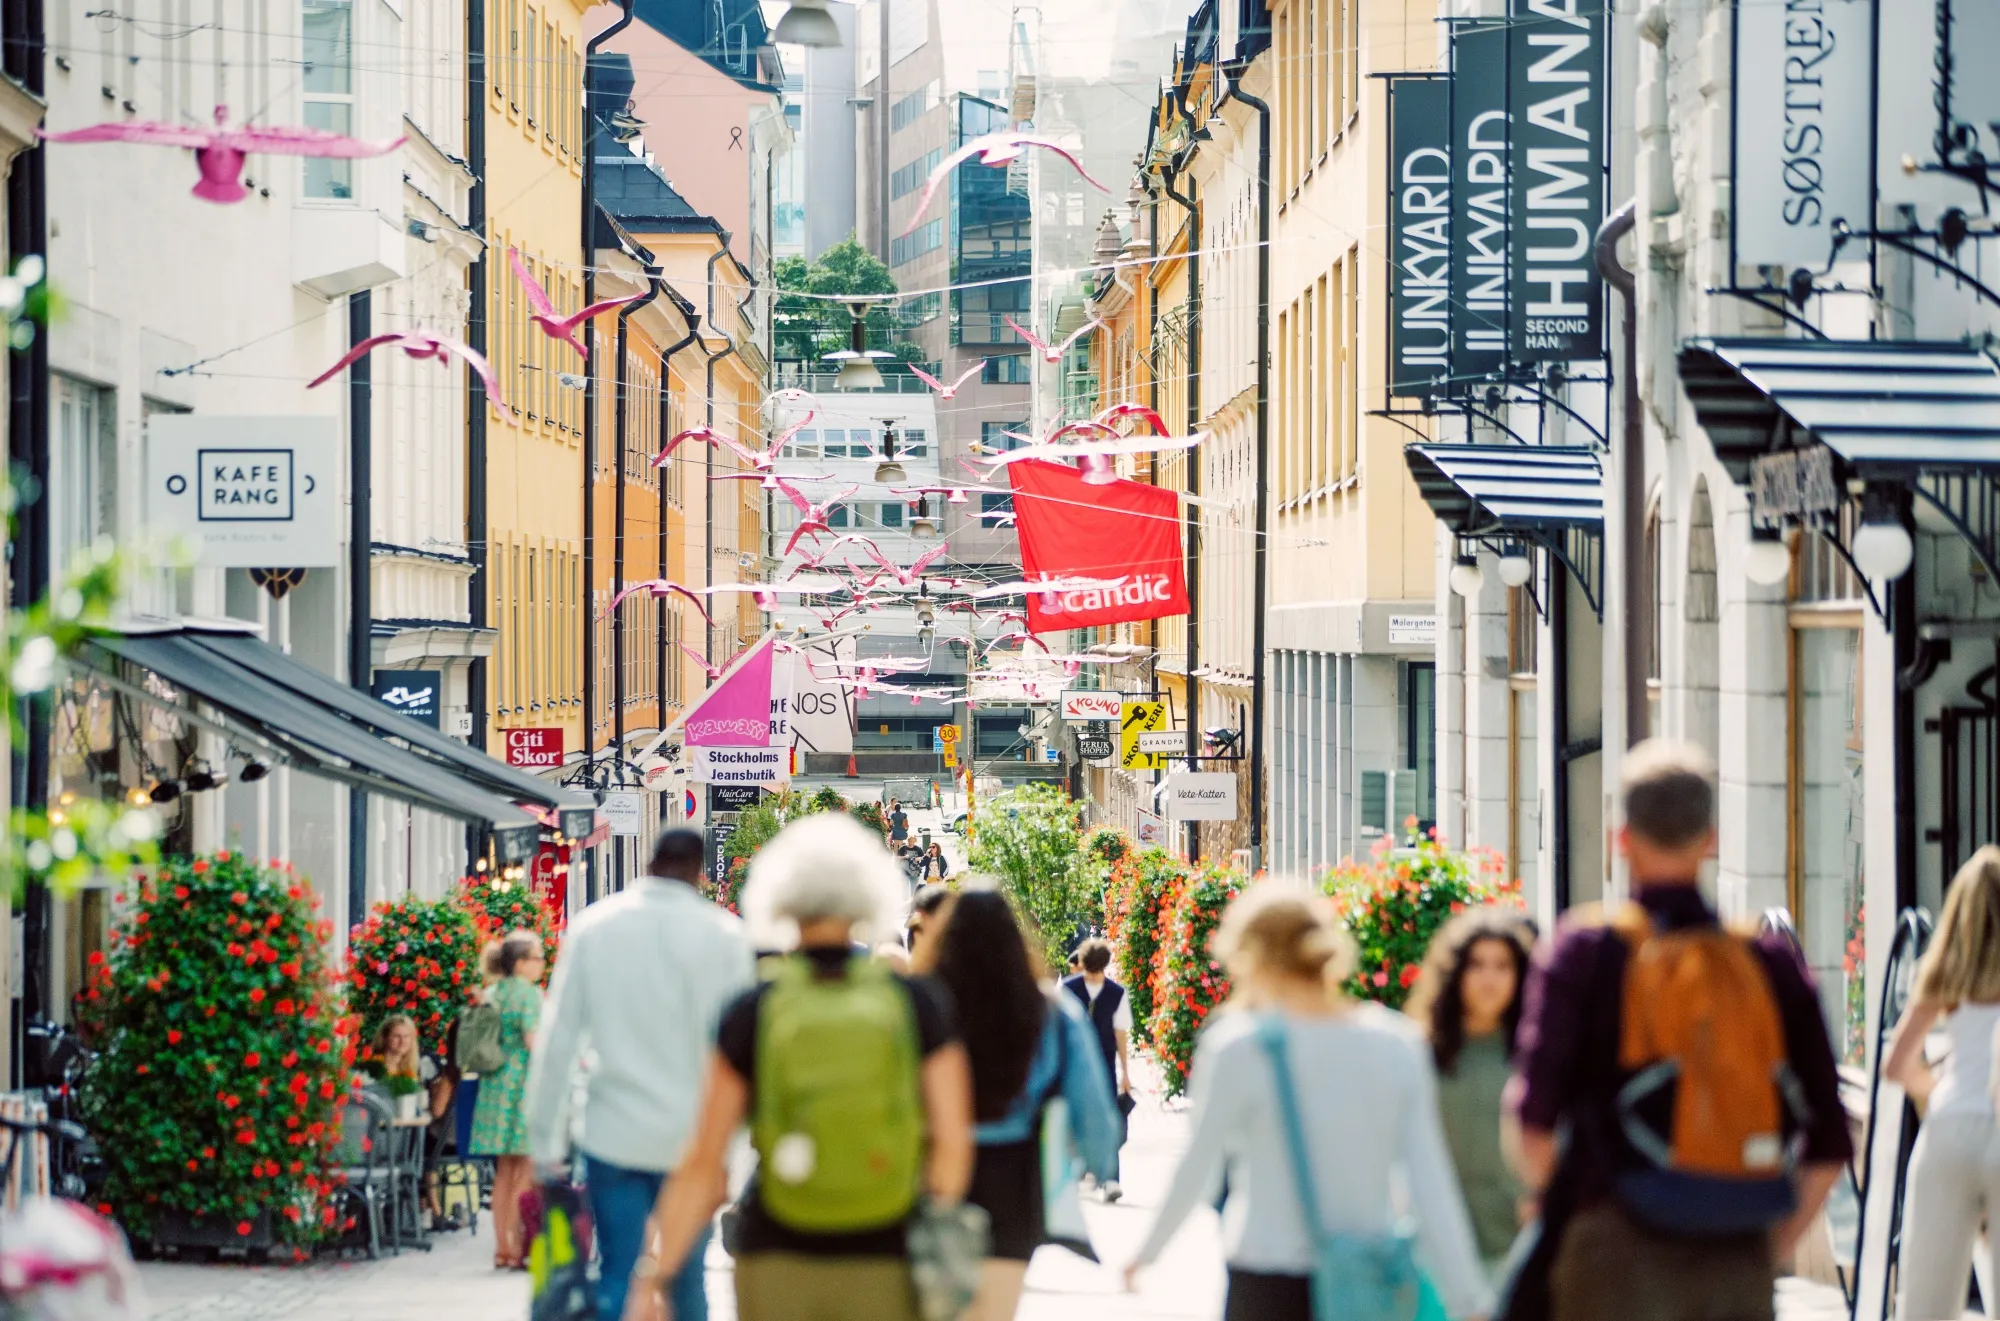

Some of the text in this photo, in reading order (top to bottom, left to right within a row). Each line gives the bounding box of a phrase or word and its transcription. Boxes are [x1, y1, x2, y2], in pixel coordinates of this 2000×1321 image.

[1525, 0, 1591, 316] HUMANA
[1525, 319, 1589, 334] SECOND
[213, 466, 279, 482] KAFE
[213, 488, 279, 505] RANG
[1042, 573, 1172, 614] candic
[459, 719, 469, 730] 15
[509, 731, 544, 747] Citi
[942, 729, 953, 738] 30
[1080, 741, 1110, 749] PERUK
[709, 751, 779, 763] Stockholms
[711, 769, 776, 781] Jeansbutik
[717, 788, 754, 798] HairCare
[1177, 789, 1227, 799] Vete-Katten
[716, 845, 726, 881] DROP
